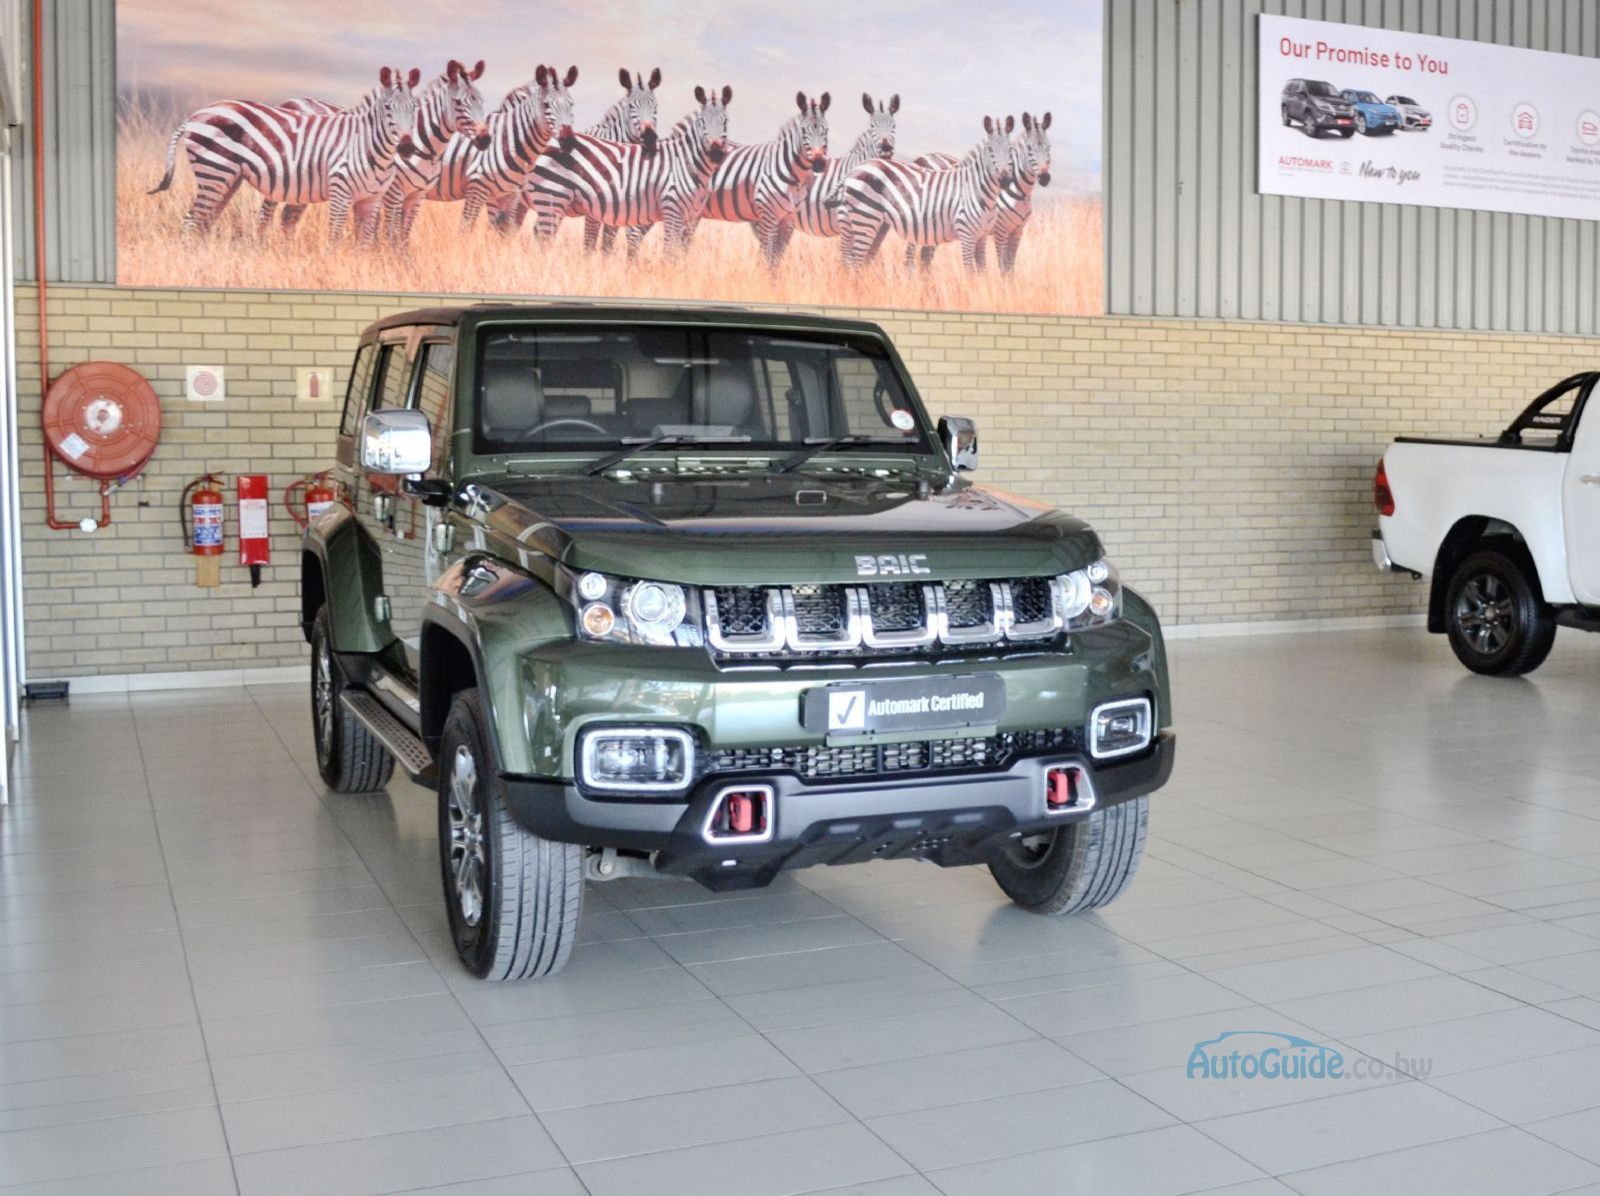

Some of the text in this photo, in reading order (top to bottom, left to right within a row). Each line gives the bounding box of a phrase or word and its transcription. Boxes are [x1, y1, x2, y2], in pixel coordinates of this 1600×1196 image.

[1280, 37, 1448, 74] Our Promise to You
[1278, 156, 1333, 169] AUTOMARK
[1359, 160, 1421, 185] New to you
[854, 554, 931, 576] BAIC
[868, 692, 984, 716] Automark Certified
